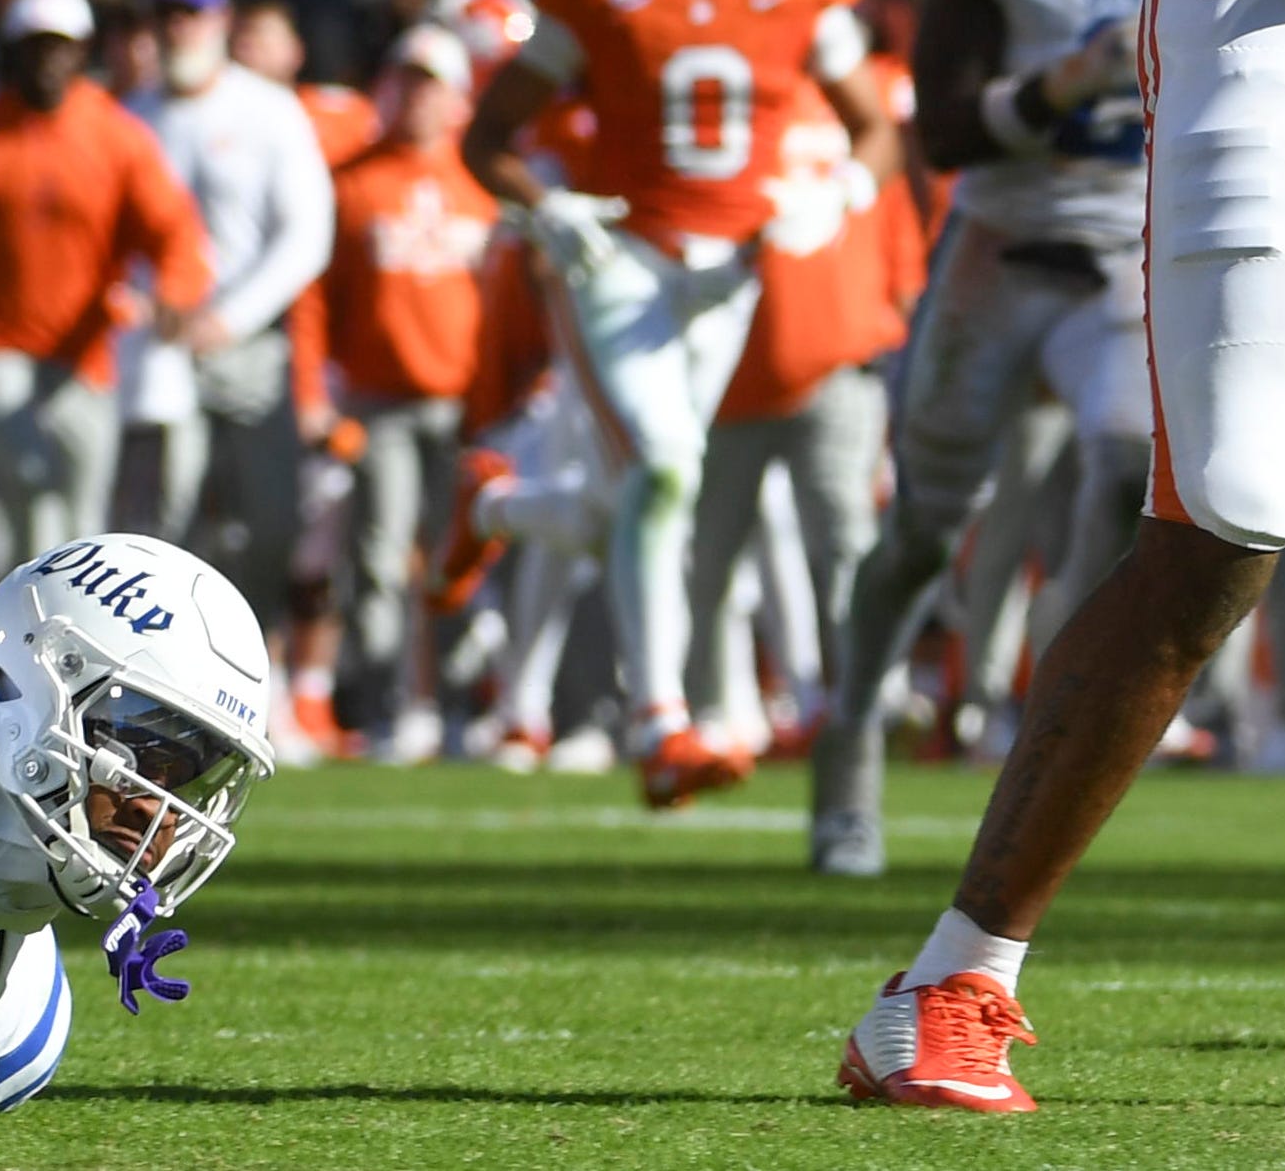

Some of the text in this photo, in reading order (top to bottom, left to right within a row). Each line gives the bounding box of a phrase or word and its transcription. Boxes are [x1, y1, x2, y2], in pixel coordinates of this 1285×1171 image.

[661, 44, 753, 182] 0
[30, 542, 175, 637] Duke
[215, 689, 258, 728] DUKE
